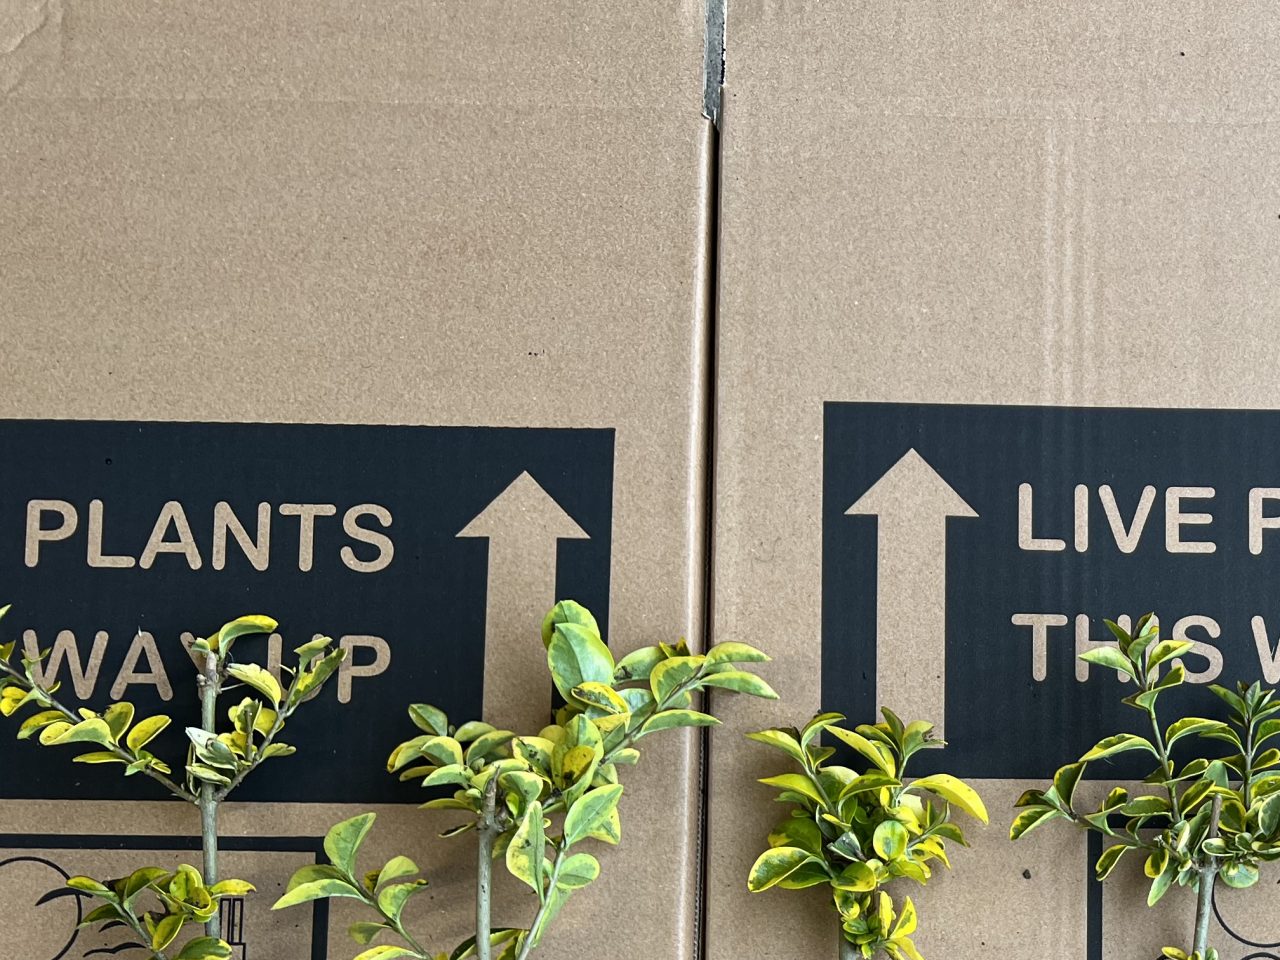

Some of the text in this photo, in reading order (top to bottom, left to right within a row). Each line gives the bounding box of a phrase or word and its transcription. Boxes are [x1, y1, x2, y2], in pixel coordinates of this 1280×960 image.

[24, 498, 396, 574] PLANTS
[1017, 482, 1217, 554] LIVE
[1010, 612, 1224, 684] THIS
